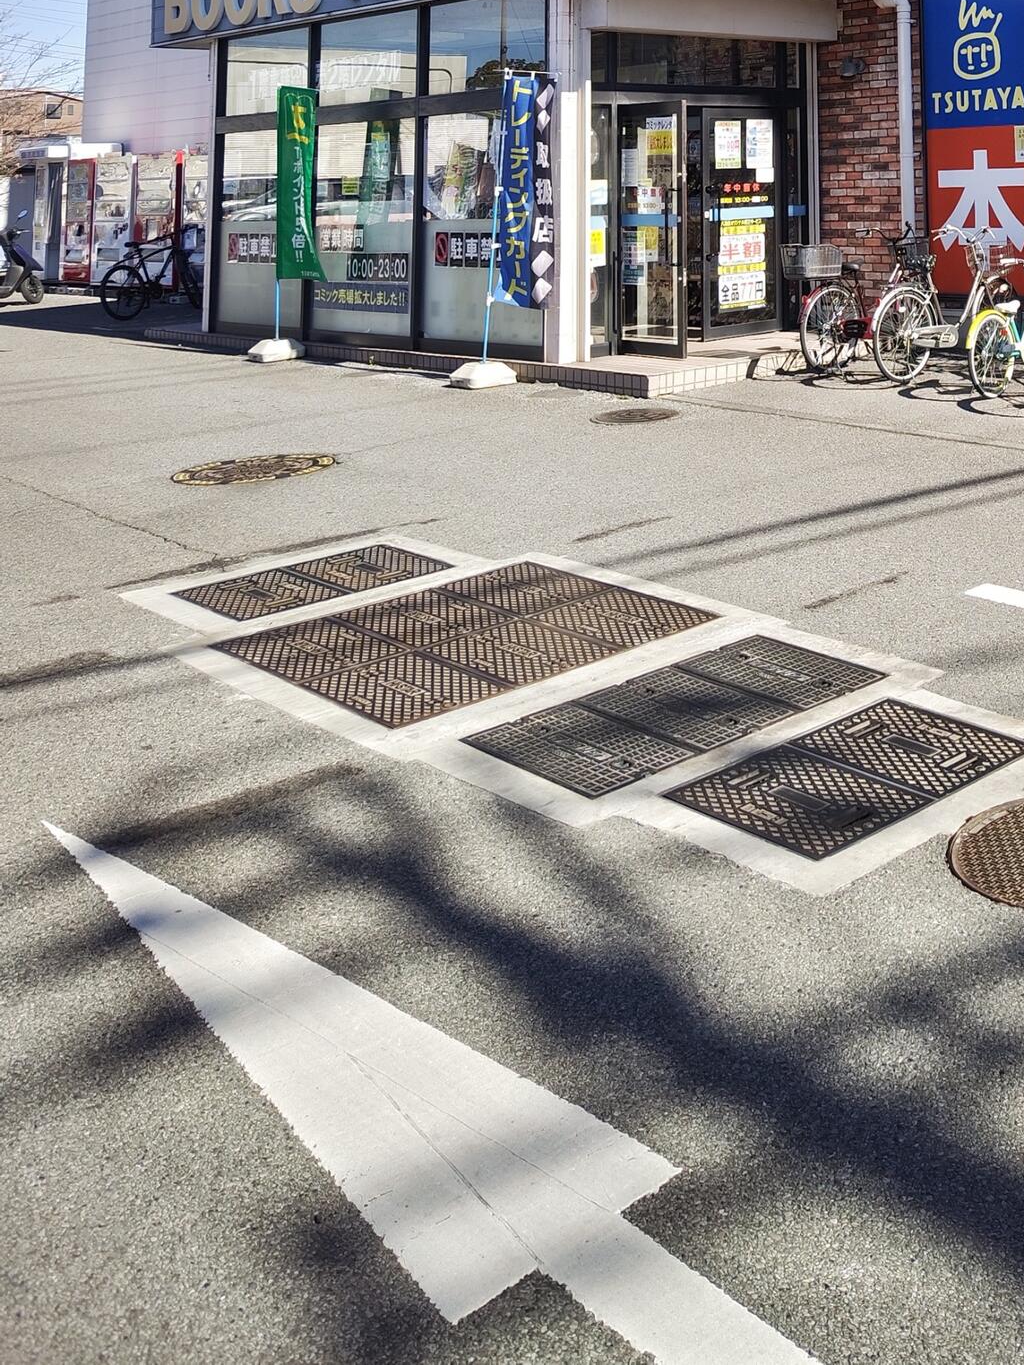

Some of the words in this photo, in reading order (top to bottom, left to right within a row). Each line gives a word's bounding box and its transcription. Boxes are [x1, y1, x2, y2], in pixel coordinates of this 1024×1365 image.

[504, 79, 534, 301] トレーディングカード
[532, 141, 554, 244] 取扱店
[321, 228, 364, 251] 営業時間
[450, 237, 501, 261] 駐車禁
[720, 242, 762, 260] 半額
[348, 258, 407, 279] 10:00-23:00
[721, 280, 764, 303] 全品77円
